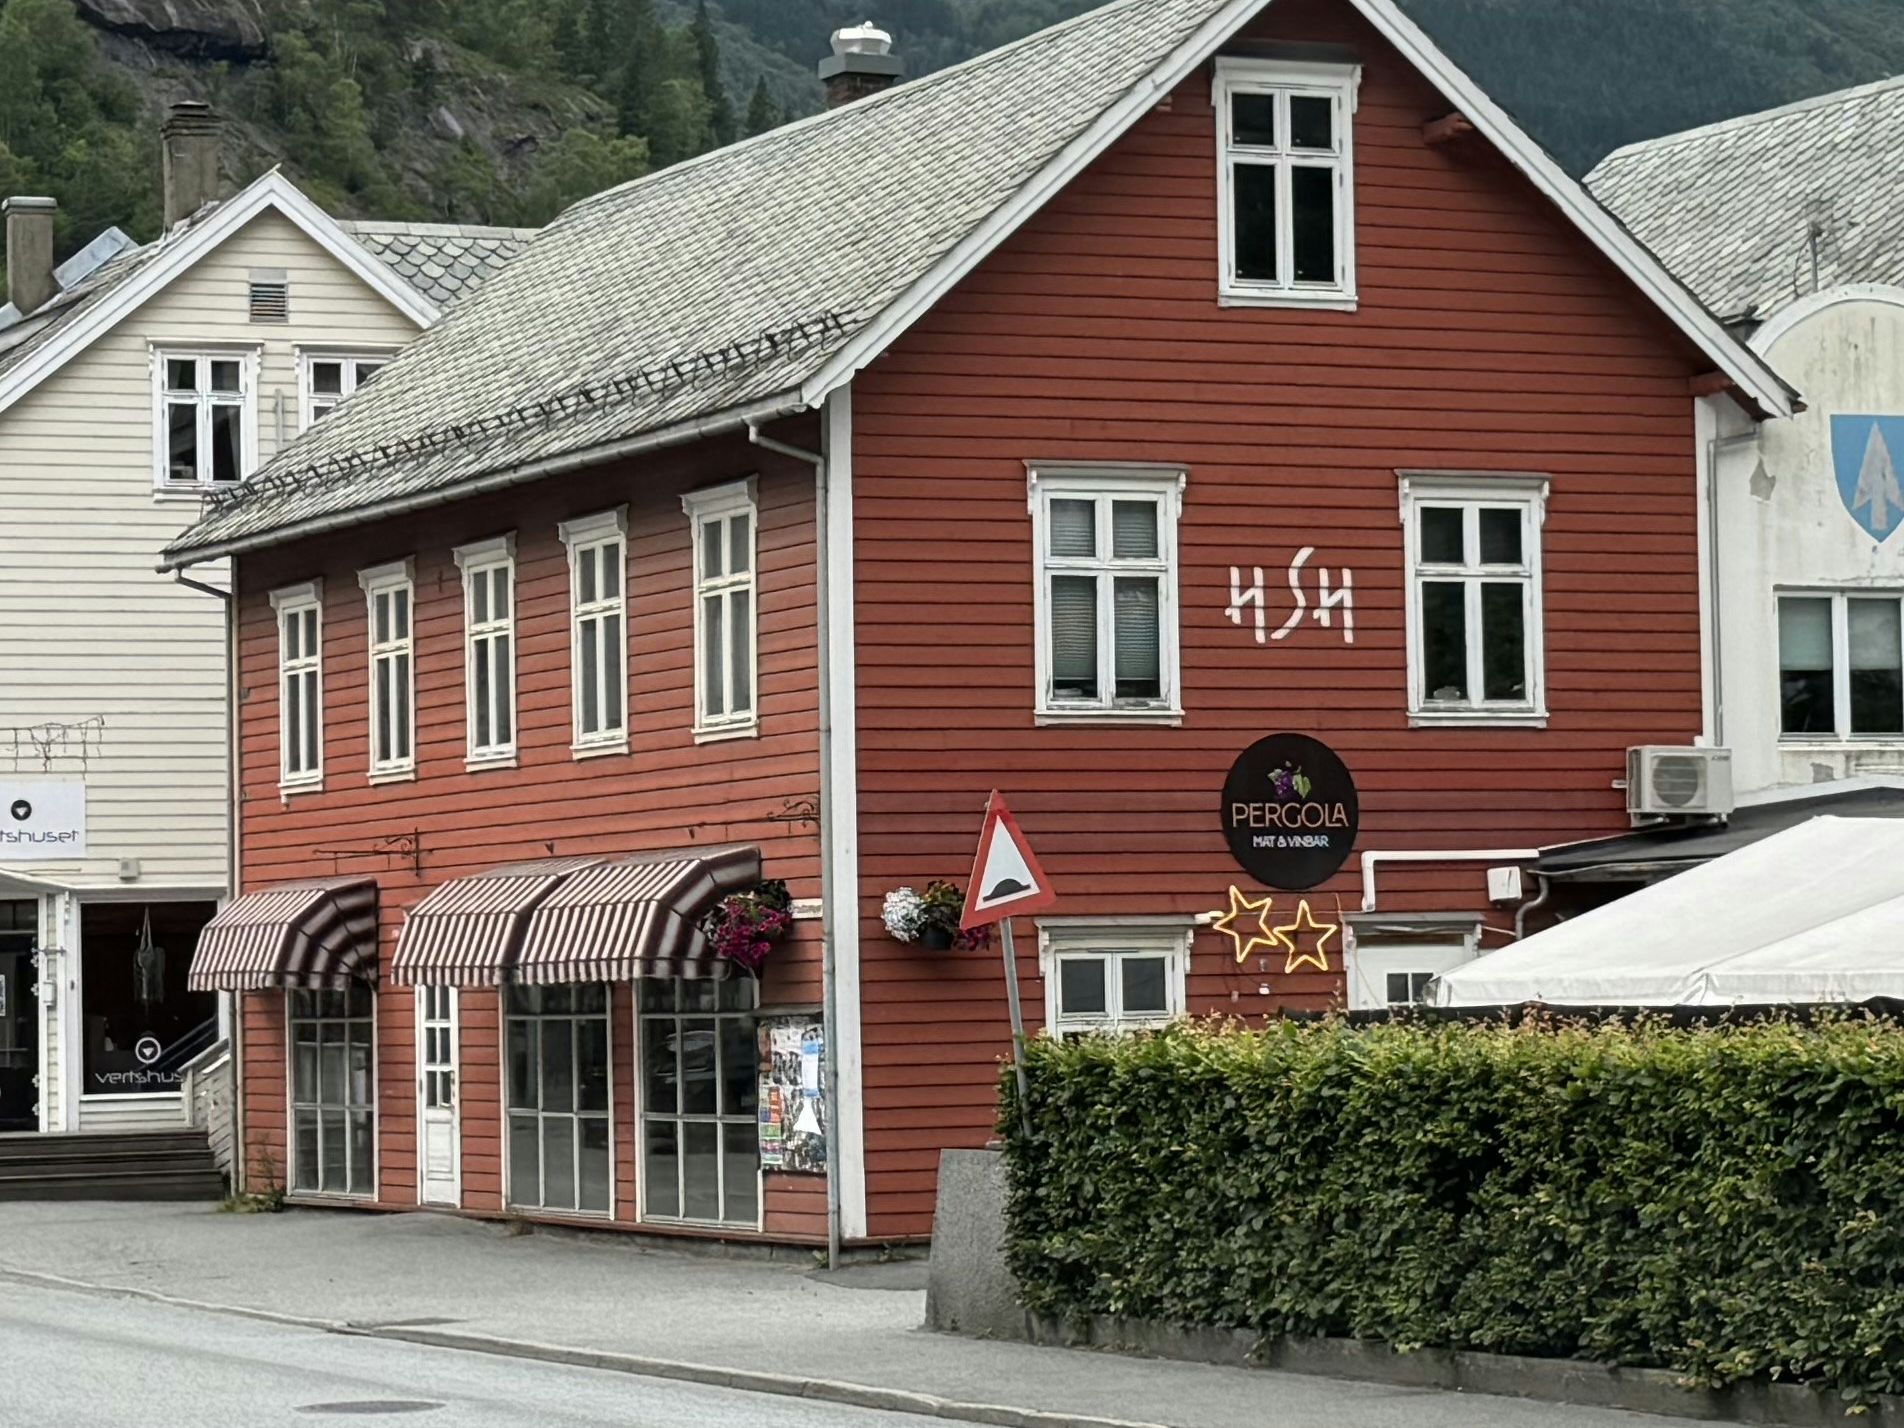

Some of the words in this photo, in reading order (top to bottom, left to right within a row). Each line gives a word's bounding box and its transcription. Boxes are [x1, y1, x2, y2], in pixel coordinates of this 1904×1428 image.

[1225, 547, 1353, 643] HSH
[1232, 802, 1348, 828] PERGOLA
[1252, 835, 1276, 848] MAT
[1276, 835, 1287, 848] &
[1287, 834, 1330, 848] VINBAR
